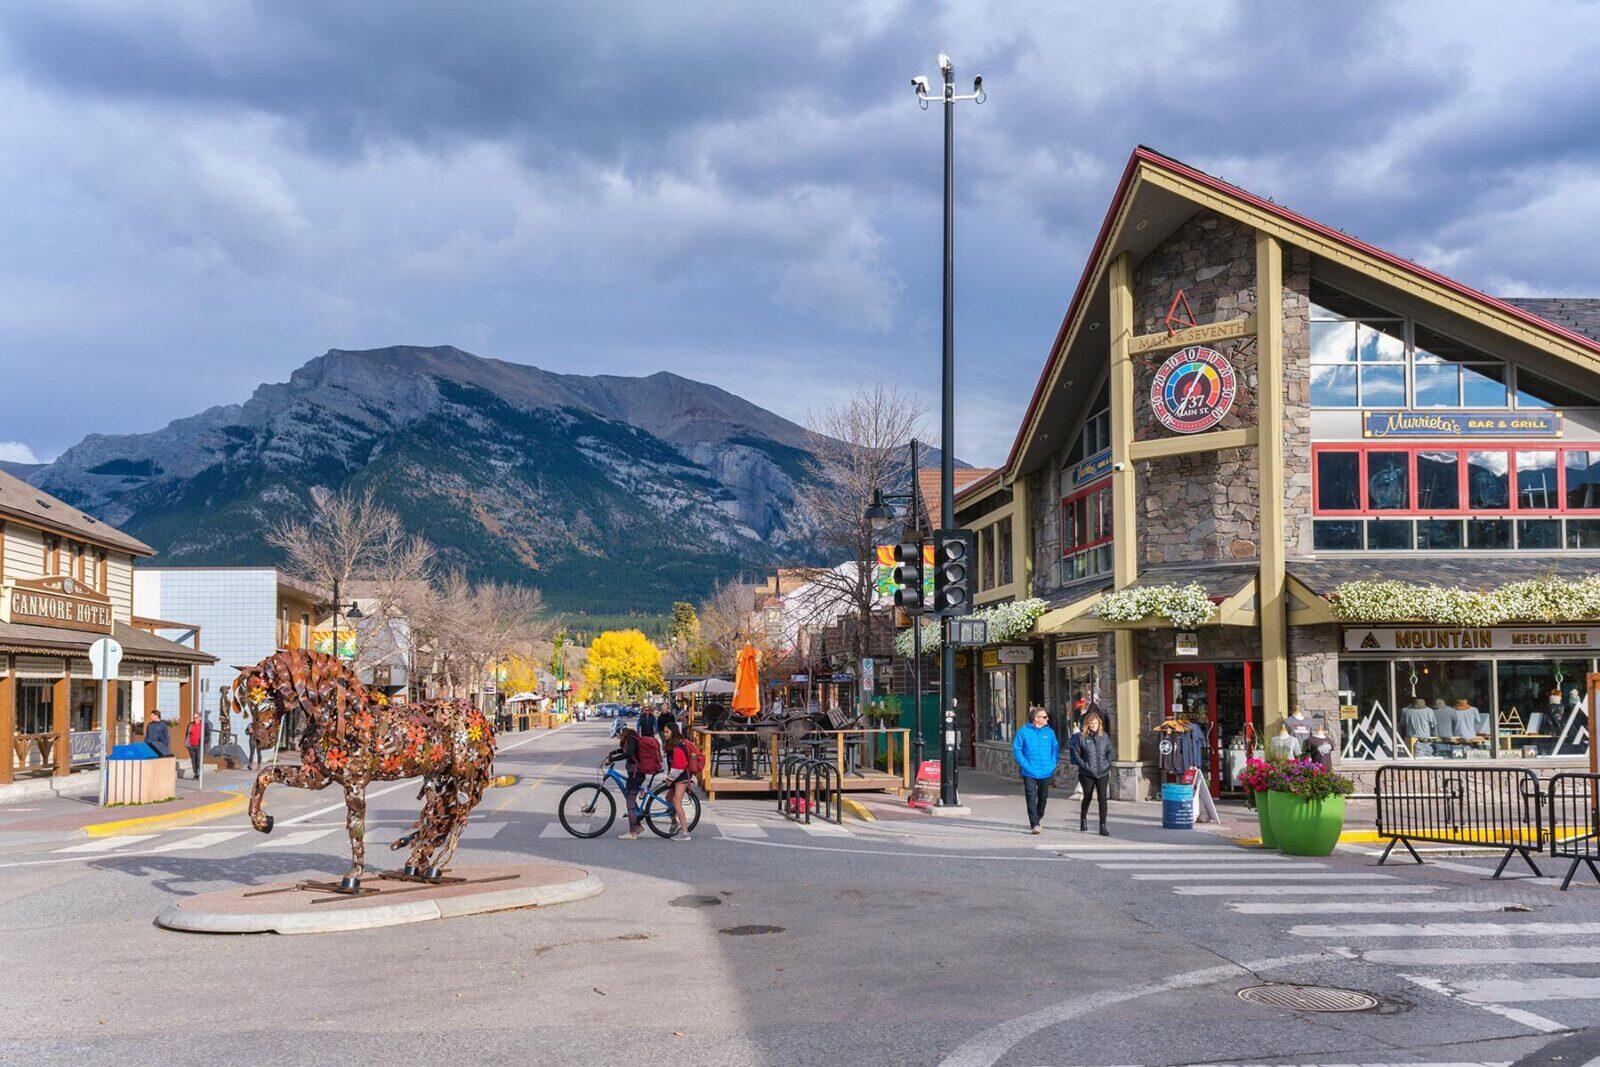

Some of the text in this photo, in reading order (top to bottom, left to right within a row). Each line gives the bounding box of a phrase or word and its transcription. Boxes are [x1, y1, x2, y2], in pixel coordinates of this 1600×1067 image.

[1187, 322, 1246, 341] SEVENTH
[1188, 349, 1196, 360] 0
[1375, 412, 1548, 437] Murrieta's BAR & GRILL
[12, 593, 111, 626] CANMORE HOTEL
[1395, 630, 1588, 649] MOUNTAIN MERCANTILE
